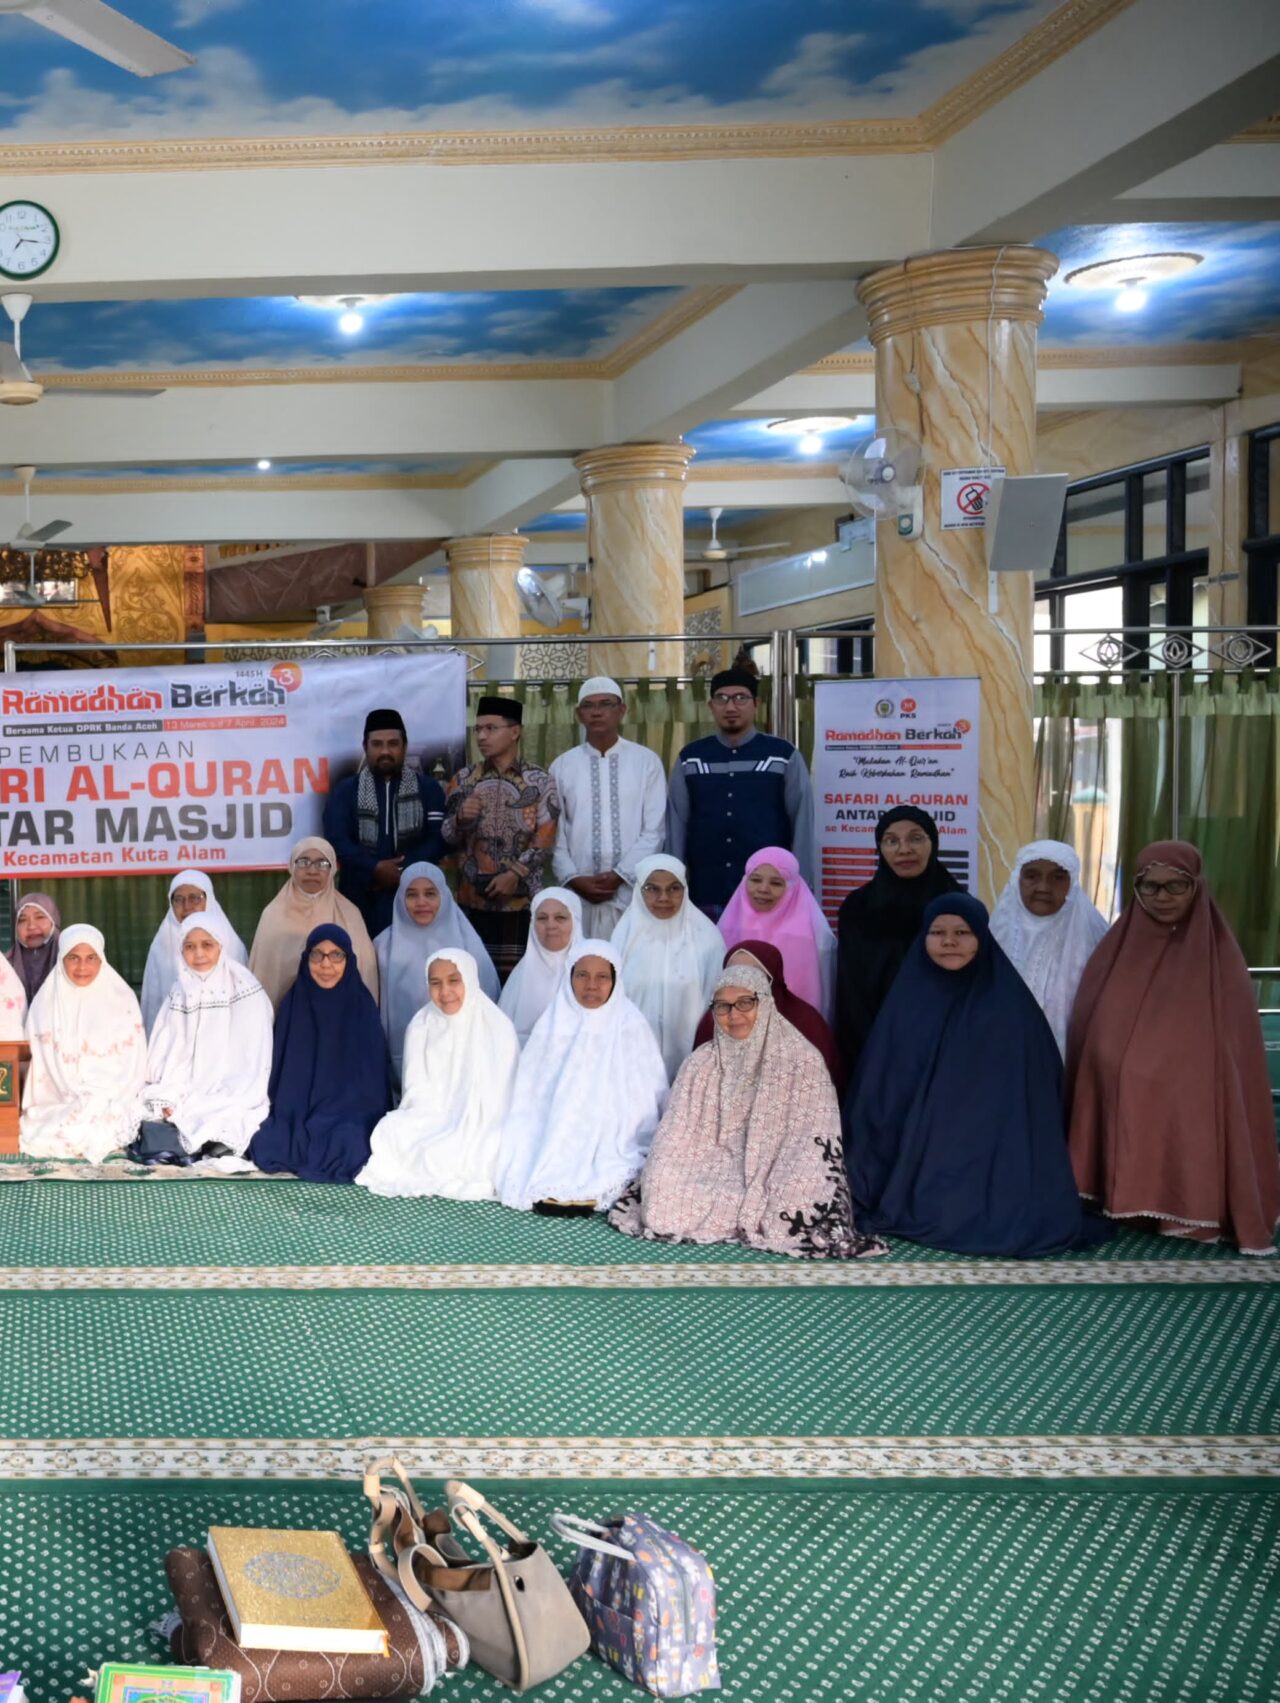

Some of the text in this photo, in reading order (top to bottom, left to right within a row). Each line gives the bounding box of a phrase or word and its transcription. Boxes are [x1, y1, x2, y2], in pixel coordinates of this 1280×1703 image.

[6, 214, 12, 224] 11
[17, 210, 26, 219] 12
[41, 223, 48, 232] 2
[45, 235, 51, 244] 3
[6, 257, 11, 266] 7
[18, 261, 25, 270] 6
[31, 257, 38, 266] 5
[2, 678, 286, 715] Ramadhan Berkah
[5, 722, 158, 735] Bersama Ketua DPRK Banda Aceh
[825, 727, 962, 741] Ramadhan Berkah
[66, 757, 330, 802] AL-QURAN
[824, 793, 968, 806] SAFARI AL-QURAN
[95, 802, 293, 844] MASJID
[3, 850, 114, 867] Kecamatan
[121, 847, 169, 863] Kuta
[177, 844, 226, 861] Alam
